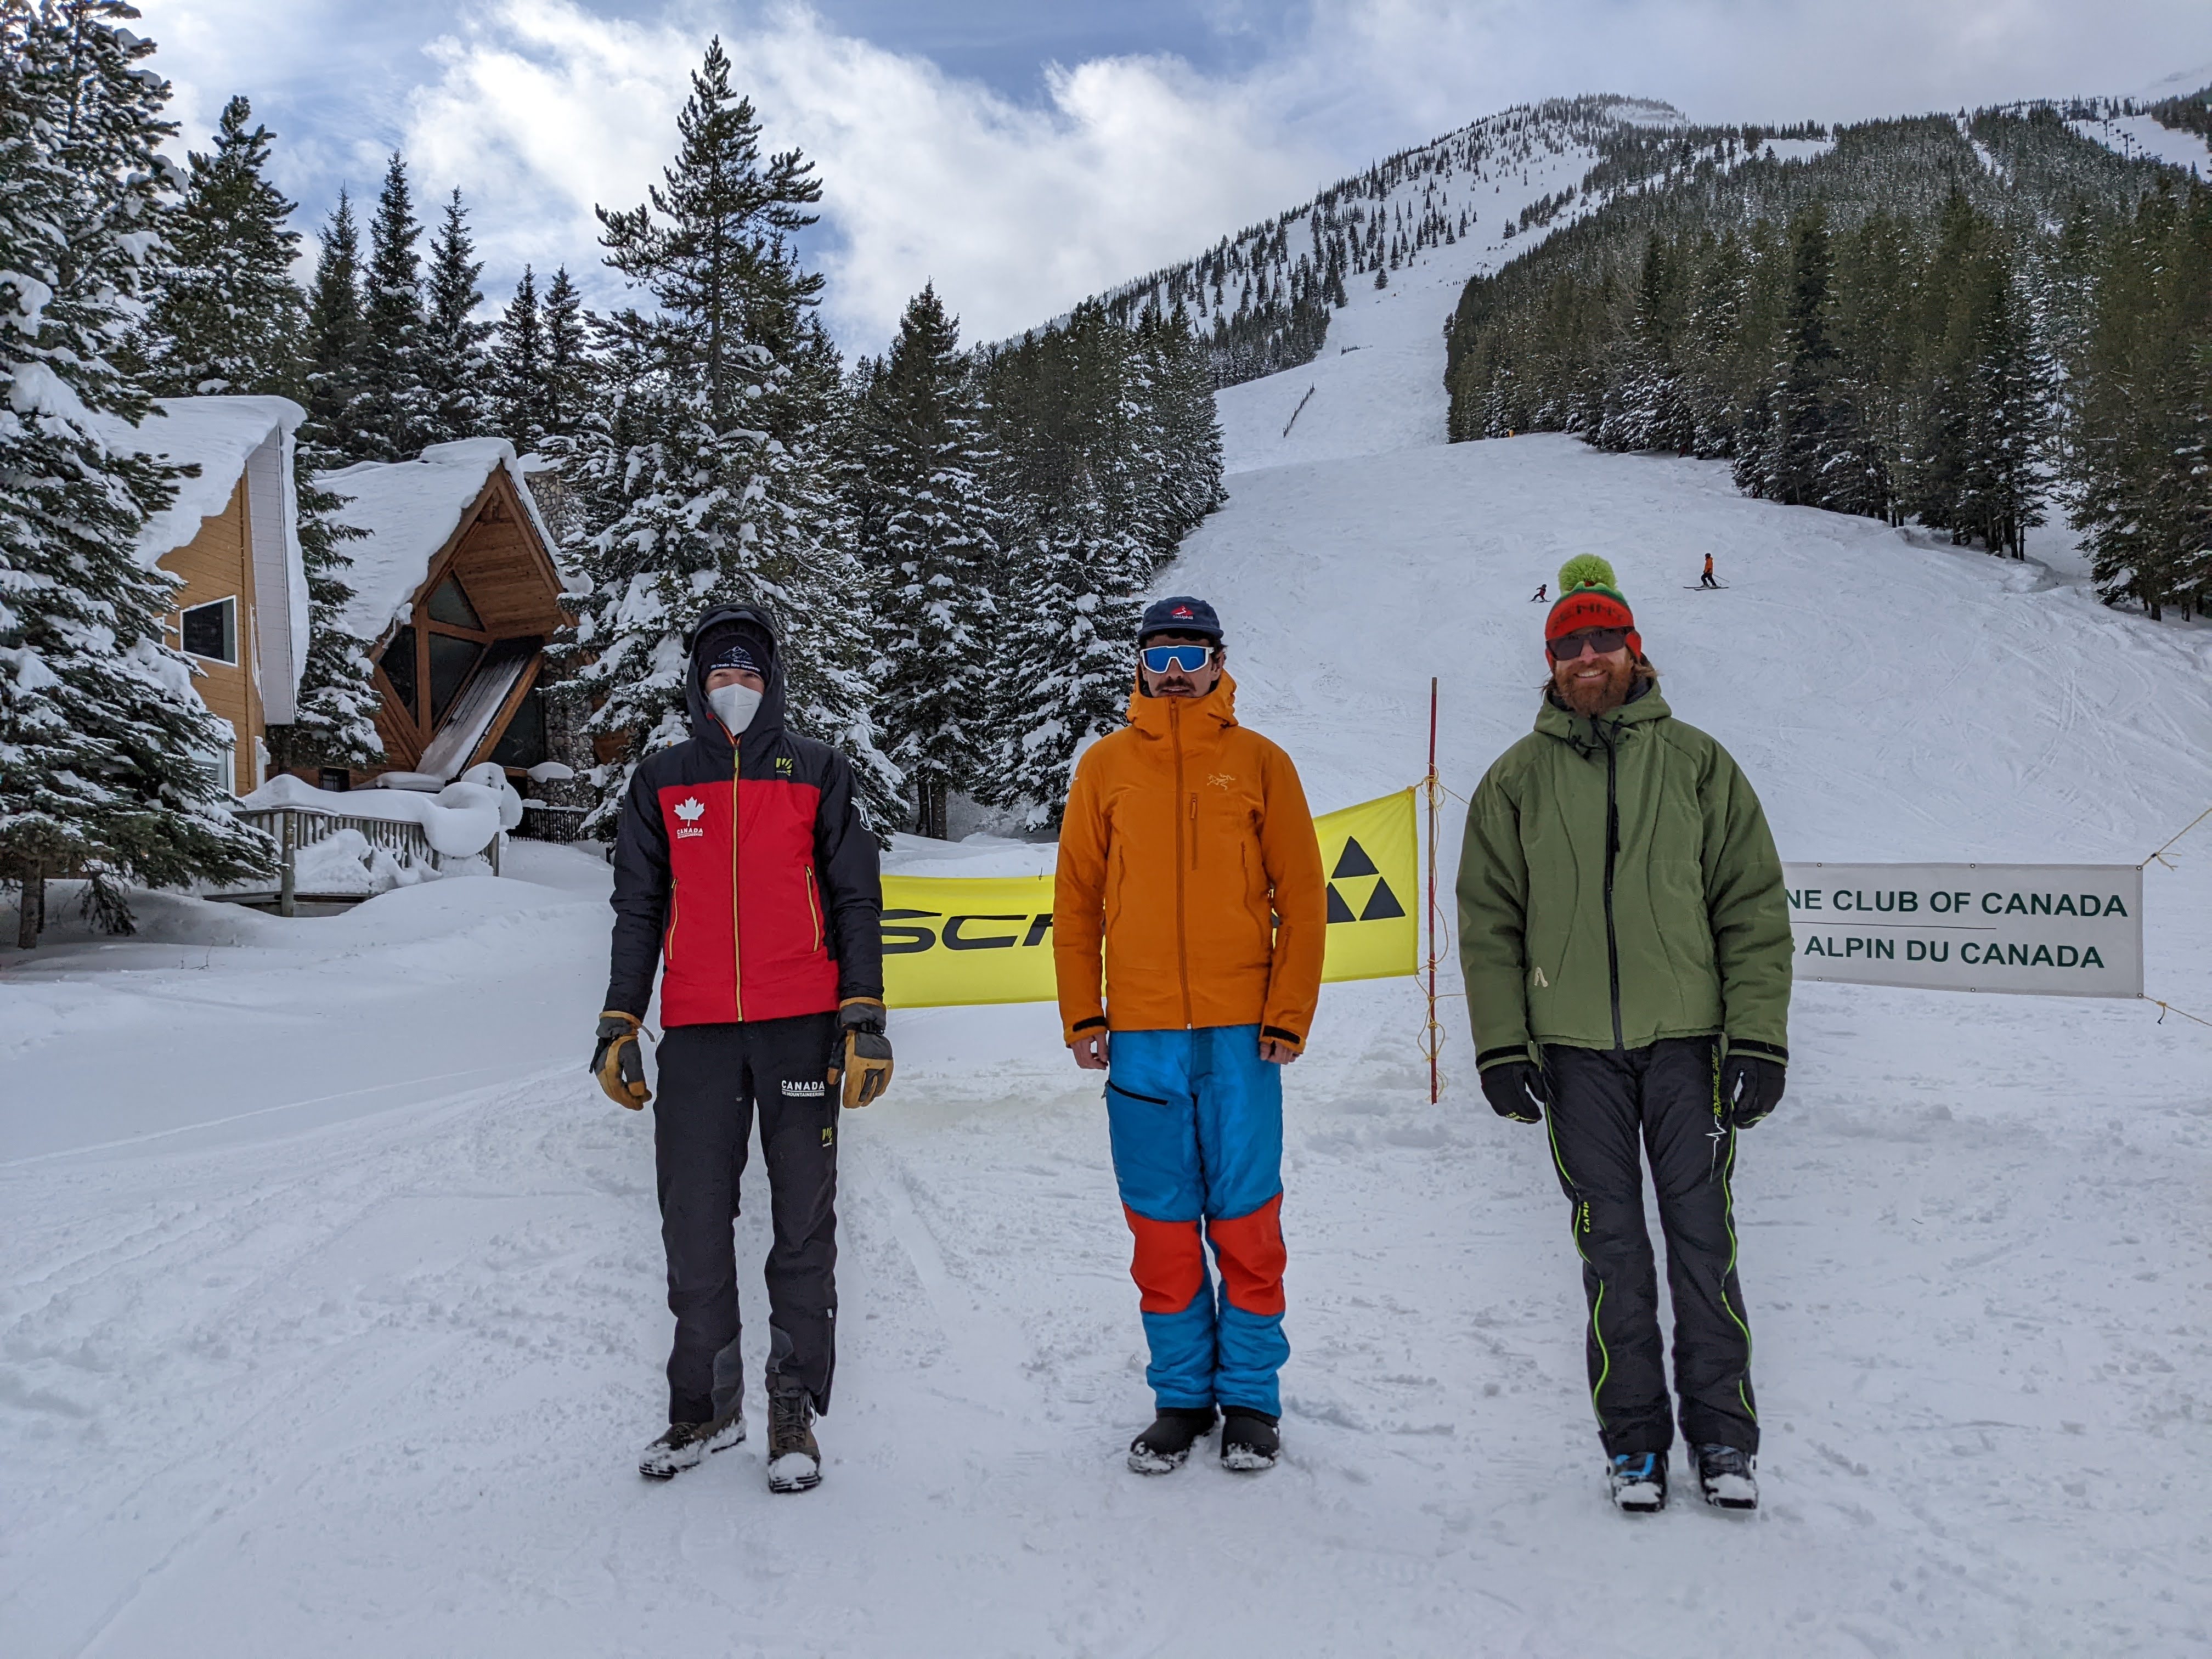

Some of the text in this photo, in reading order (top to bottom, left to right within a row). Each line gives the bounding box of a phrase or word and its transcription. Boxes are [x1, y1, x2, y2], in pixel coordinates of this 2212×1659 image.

[1785, 889, 2129, 917] NE CLUB OF CANADA
[1804, 935, 1894, 960] ALPIN
[1906, 940, 1949, 962] DU
[1960, 942, 2106, 968] CANADA
[782, 1080, 825, 1090] CANADA
